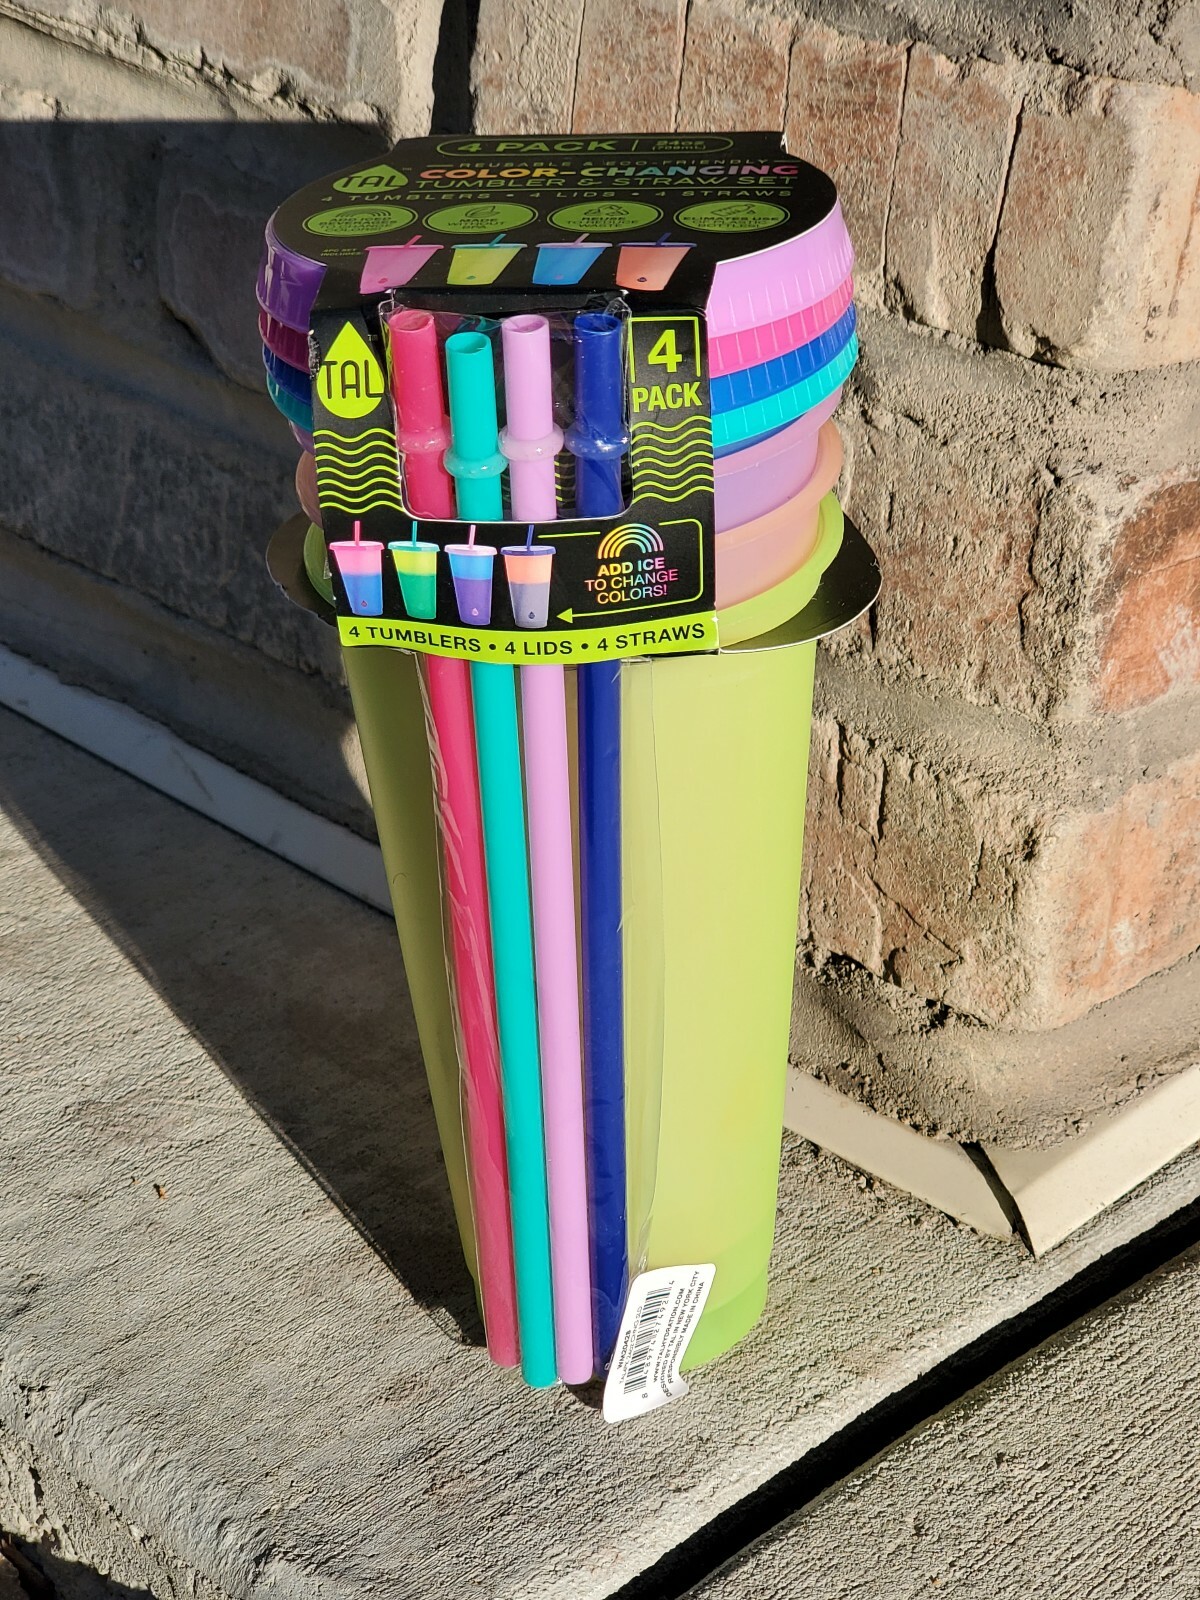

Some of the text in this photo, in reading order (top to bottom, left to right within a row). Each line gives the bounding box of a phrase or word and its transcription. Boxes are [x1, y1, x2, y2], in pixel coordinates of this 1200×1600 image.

[457, 140, 618, 153] 4 PACK
[342, 175, 403, 188] TAL
[415, 176, 798, 189] TUMBLER & STRAW SET
[419, 165, 799, 180] COLOR-CHANGING
[349, 192, 491, 201] TUMBLERS
[648, 329, 683, 373] 4
[321, 359, 387, 400] TAL
[631, 381, 703, 413] PACK
[597, 557, 665, 577] ADD ICE
[584, 569, 680, 592] TO CHANGE
[596, 584, 668, 605] COLORS!
[348, 623, 706, 656] 4 TUMBLERS 4 LIDS 4 STRAWS
[661, 1270, 700, 1397] DESIGNED BY TAL IN NEW YORK CITY
[668, 1281, 705, 1384] RESPONSIBLY MADE IN CHINA
